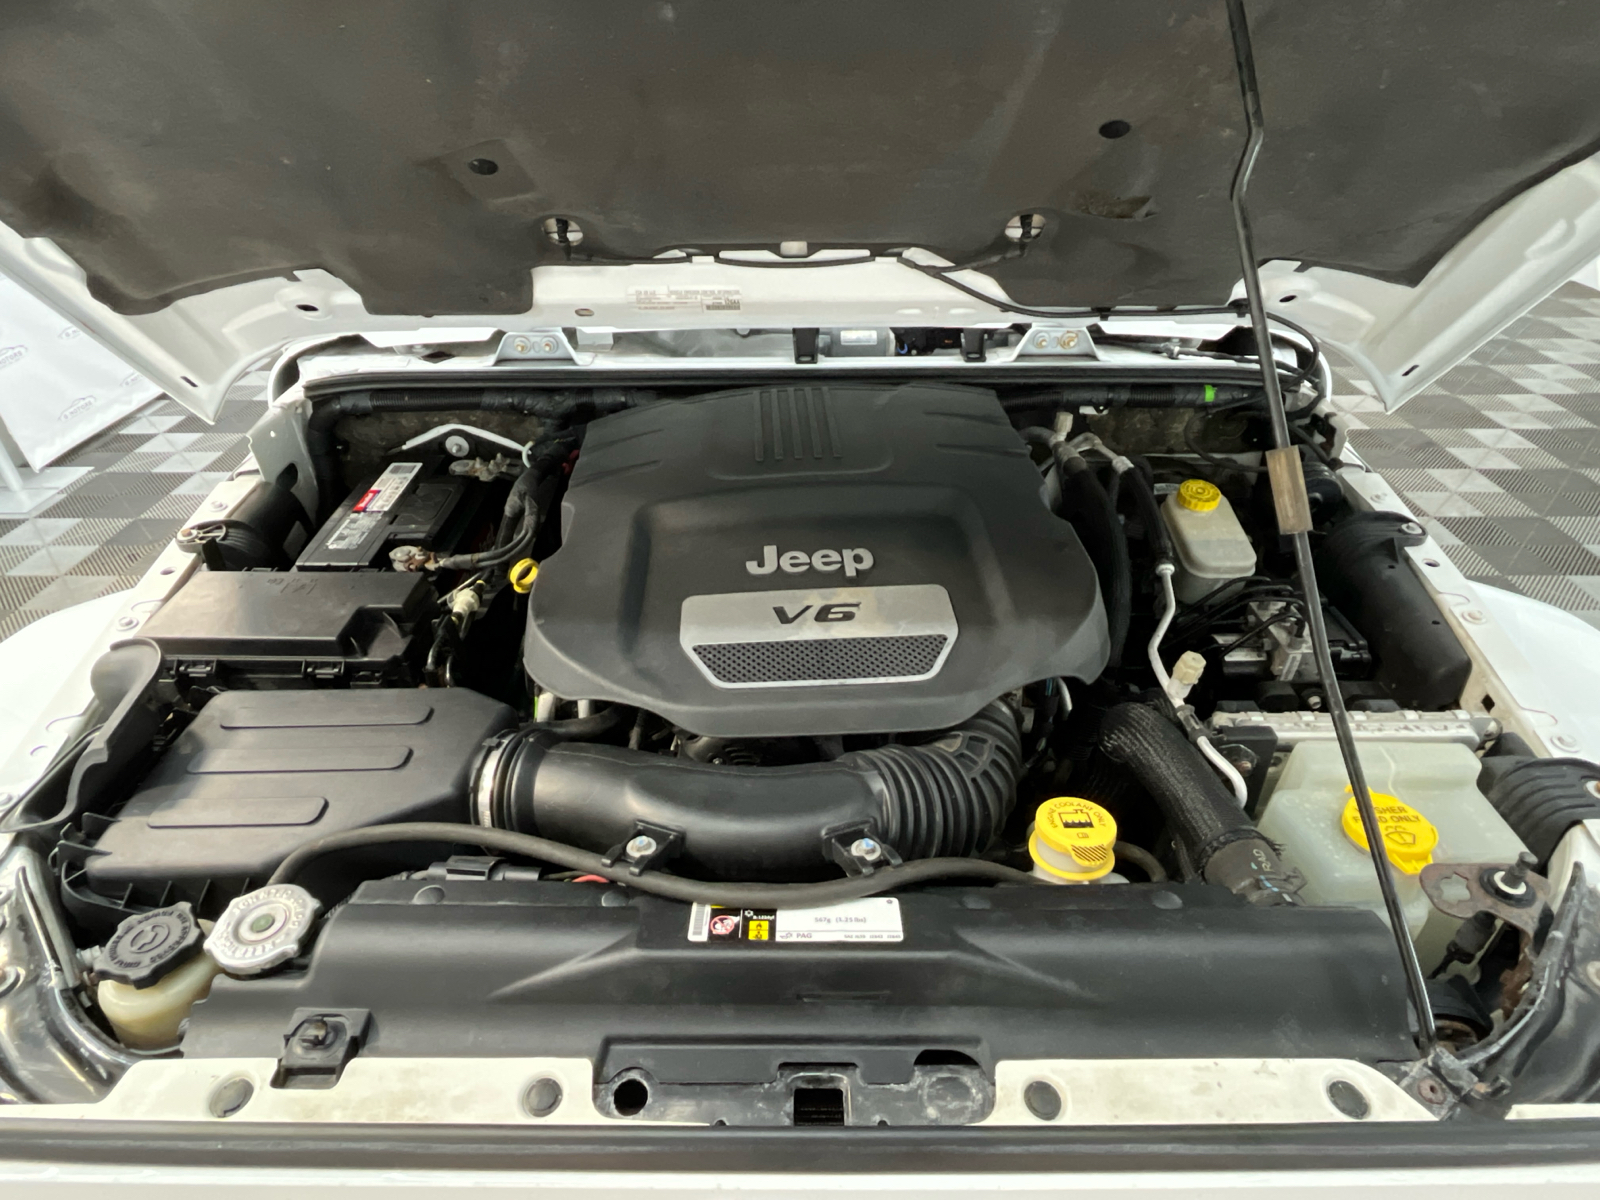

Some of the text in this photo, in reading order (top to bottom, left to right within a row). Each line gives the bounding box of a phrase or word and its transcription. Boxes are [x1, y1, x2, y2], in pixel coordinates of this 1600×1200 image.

[745, 545, 875, 577] Jeep
[772, 602, 862, 625] V6
[1054, 801, 1094, 812] COOLANT
[1093, 811, 1107, 828] ONLY
[1354, 806, 1408, 815] SHER
[1390, 815, 1421, 823] ONLY
[814, 916, 831, 924] 567g
